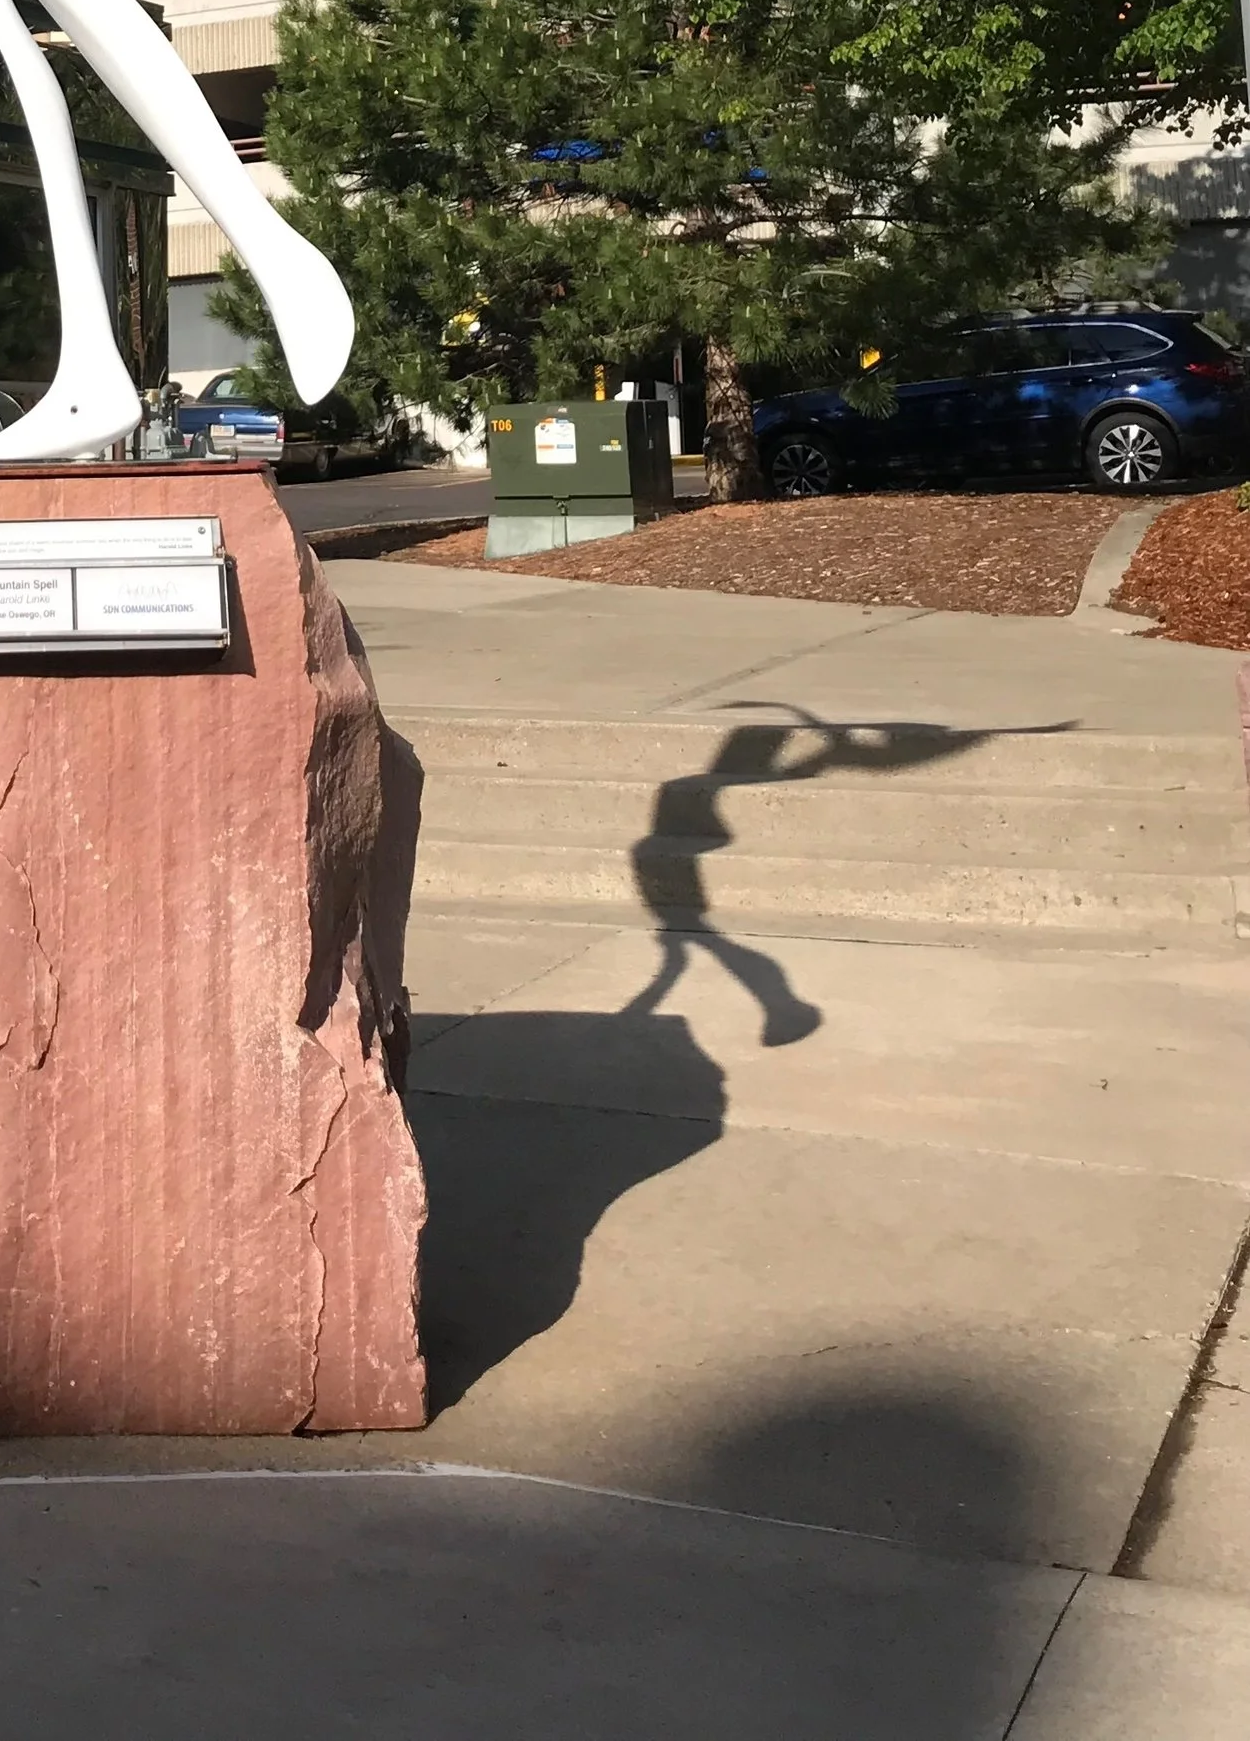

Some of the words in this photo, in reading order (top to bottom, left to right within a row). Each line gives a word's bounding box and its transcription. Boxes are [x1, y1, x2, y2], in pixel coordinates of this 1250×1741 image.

[491, 419, 512, 432] T06
[33, 579, 58, 591] Spell
[43, 610, 57, 618] OR
[103, 605, 120, 614] SDN
[121, 604, 195, 614] COMMUNICATIONS
